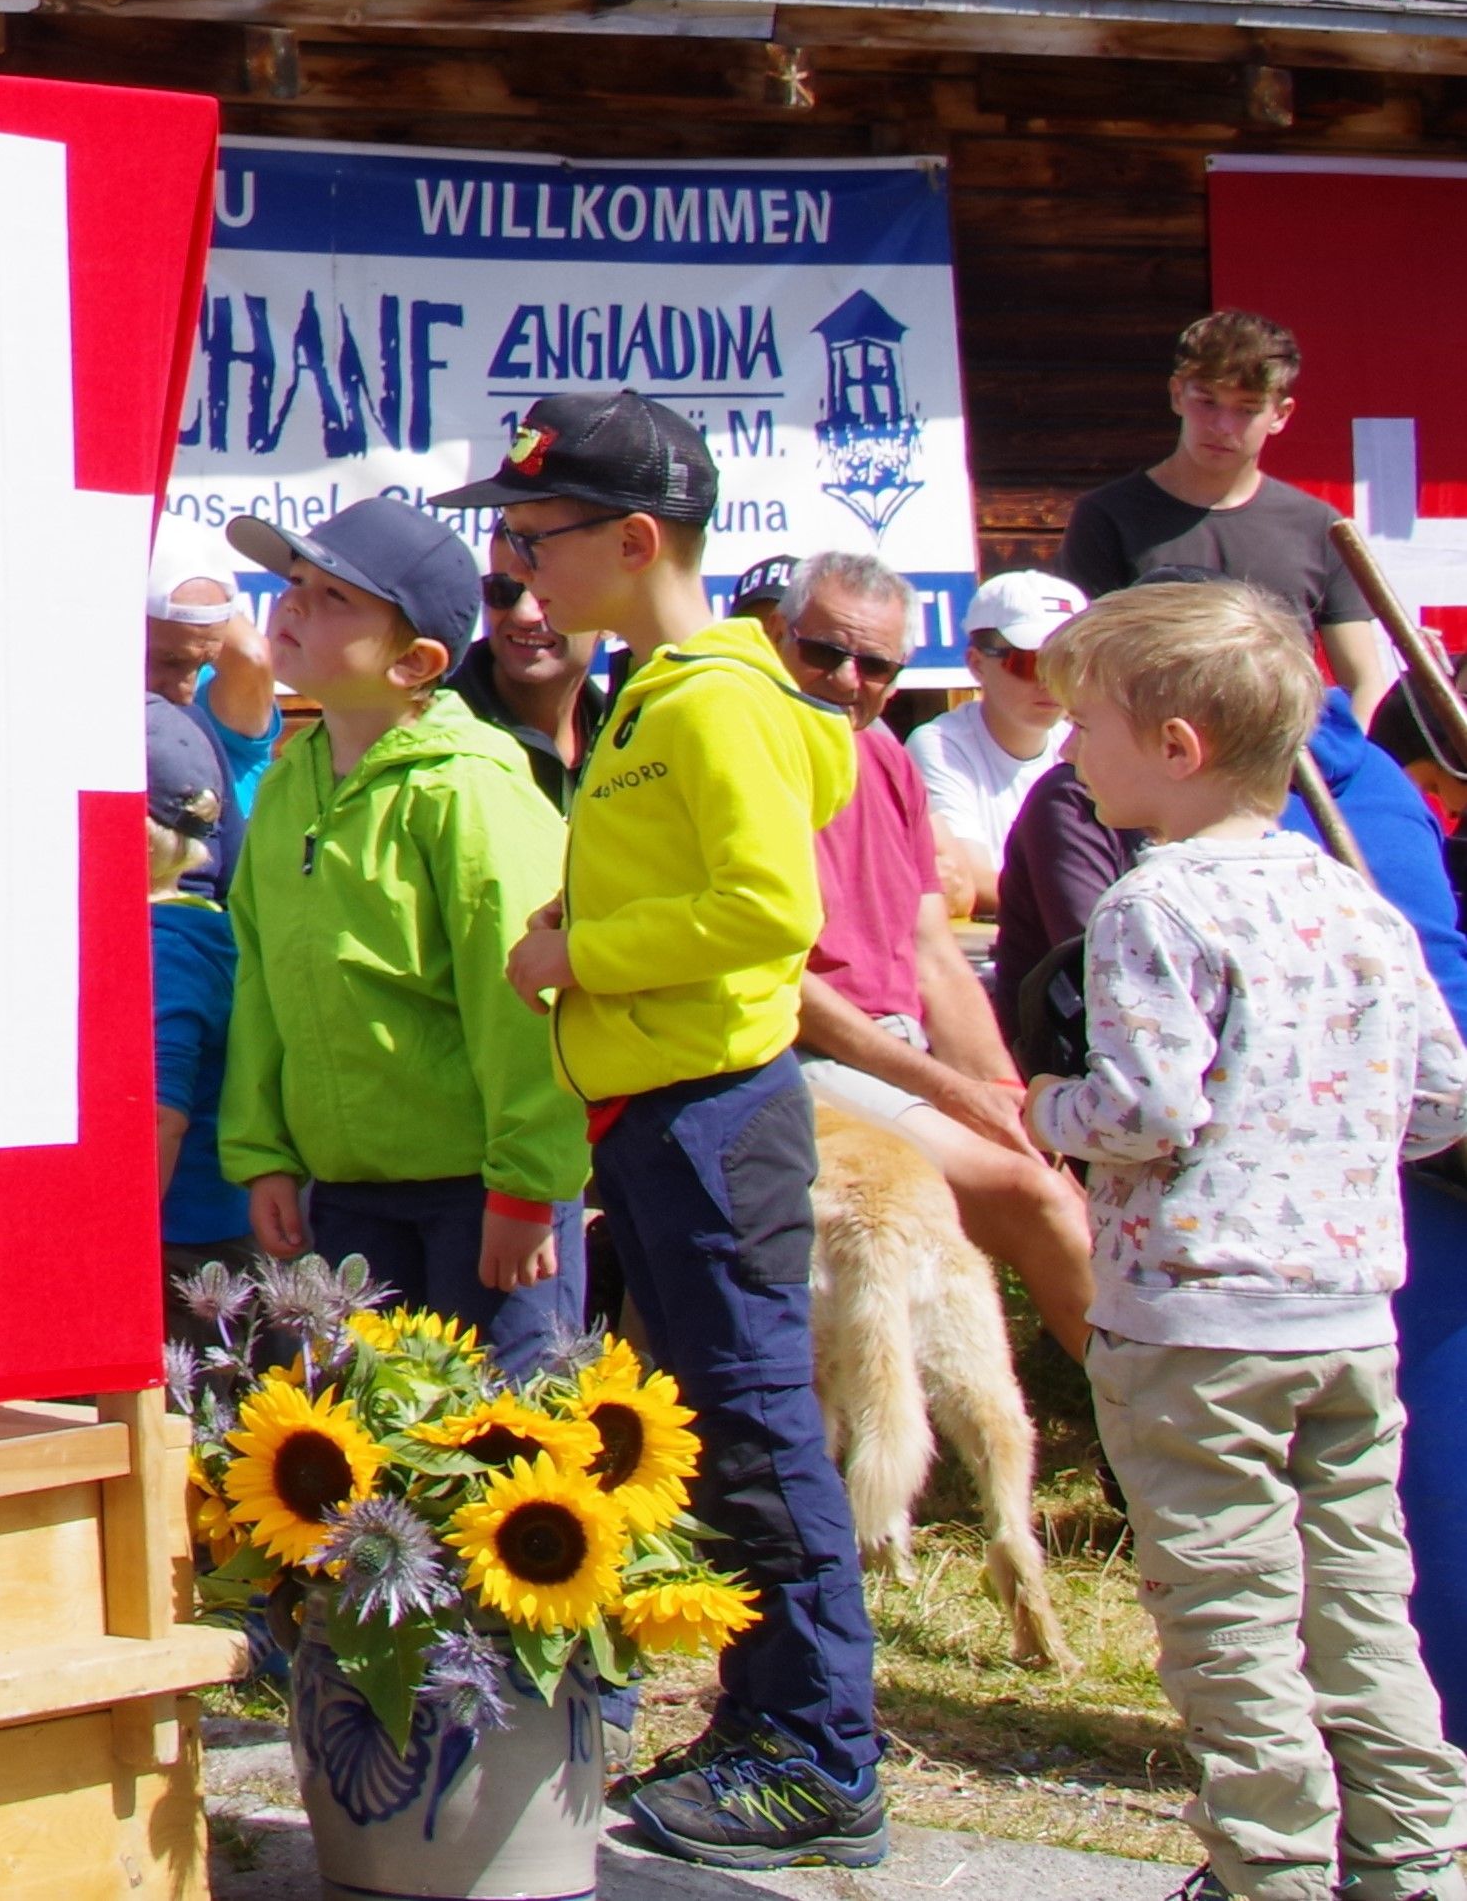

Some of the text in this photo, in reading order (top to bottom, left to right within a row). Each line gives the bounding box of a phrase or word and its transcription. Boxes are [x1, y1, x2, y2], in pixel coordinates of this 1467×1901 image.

[415, 178, 831, 244] WILLKOMMEN
[178, 285, 464, 459] HANF
[487, 302, 784, 382] ENGIADINA
[165, 481, 340, 529] os-chel
[712, 499, 789, 533] una
[610, 762, 668, 792] NORD
